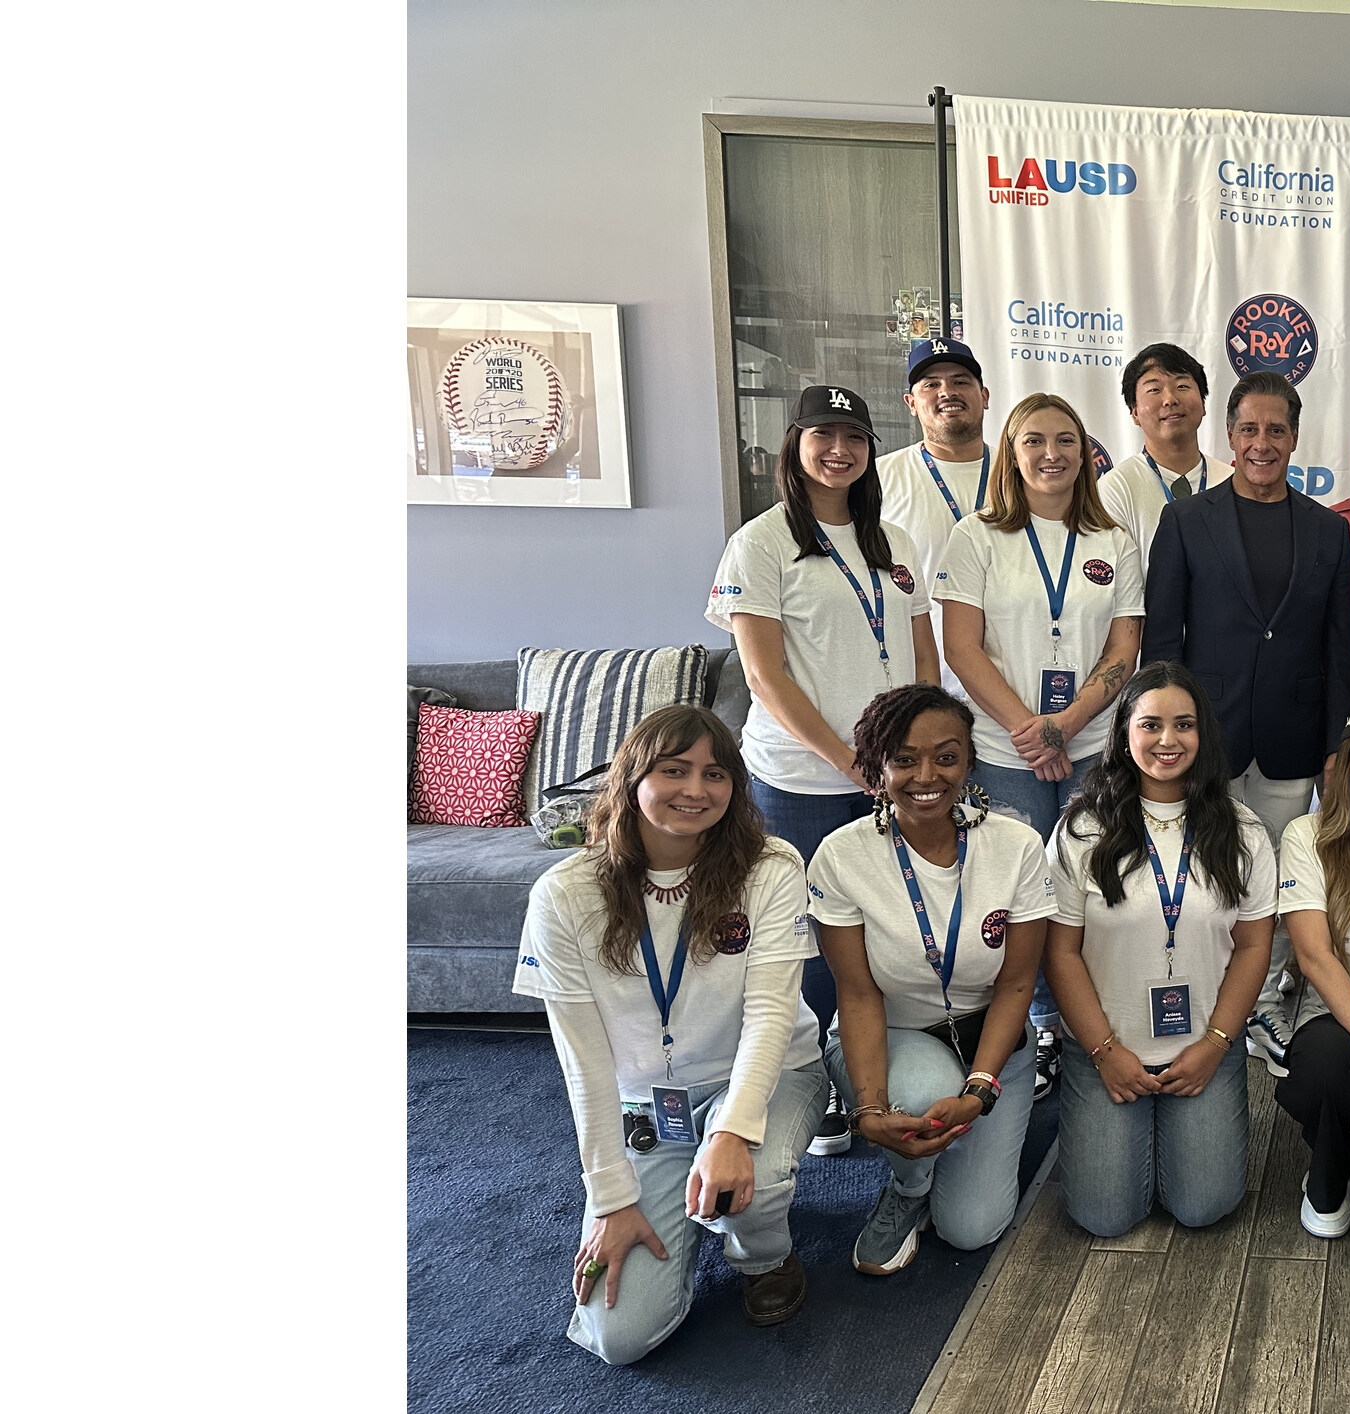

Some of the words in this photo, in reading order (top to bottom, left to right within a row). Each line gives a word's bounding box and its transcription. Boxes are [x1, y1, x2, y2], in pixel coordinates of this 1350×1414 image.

[988, 156, 1137, 196] LAUSD
[1218, 160, 1334, 192] California
[989, 190, 1049, 206] UNIFIED
[1220, 189, 1276, 203] CREDIT
[1286, 194, 1334, 206] UNION
[1220, 209, 1332, 229] FOUNDATION
[1008, 300, 1123, 331] California
[1233, 299, 1310, 336] ROOKIE
[929, 338, 949, 355] LA
[1010, 329, 1067, 341] CREDIT
[1078, 333, 1123, 345] UNION
[486, 358, 522, 368] WORLD
[1011, 348, 1122, 367] FOUNDATION
[1235, 355, 1250, 373] OF
[1285, 360, 1307, 382] EAR
[486, 377, 523, 391] SERIES
[829, 389, 852, 411] LA
[712, 586, 742, 595] AUSD
[983, 911, 1007, 930] ROOK
